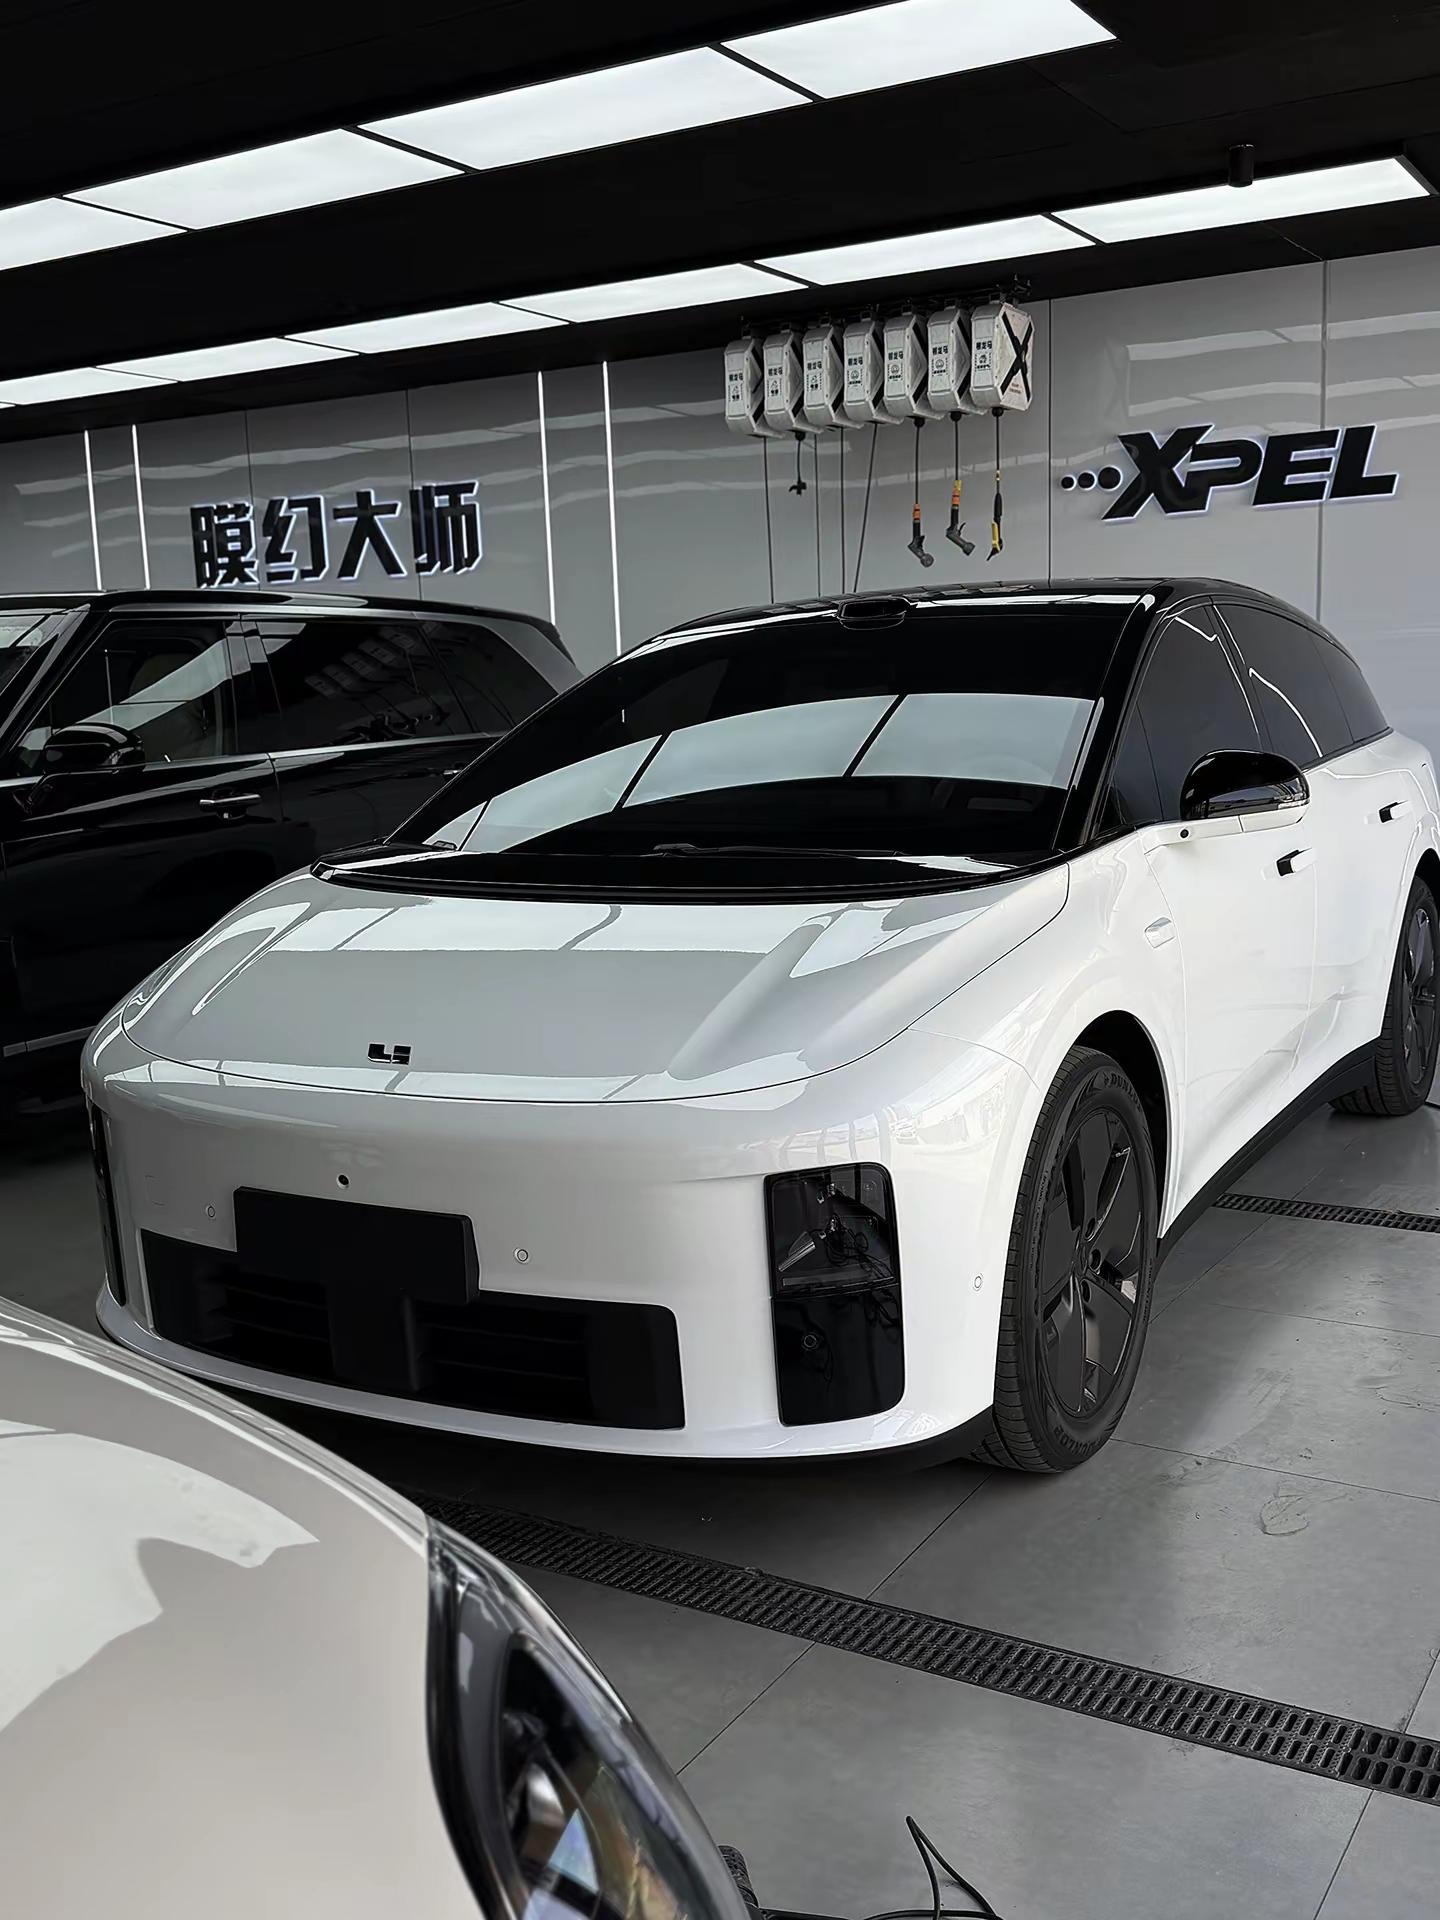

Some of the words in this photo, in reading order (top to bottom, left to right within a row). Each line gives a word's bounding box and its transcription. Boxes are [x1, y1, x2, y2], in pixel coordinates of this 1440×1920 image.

[1102, 424, 1398, 522] XPEL
[190, 480, 482, 589] 膜幻大师
